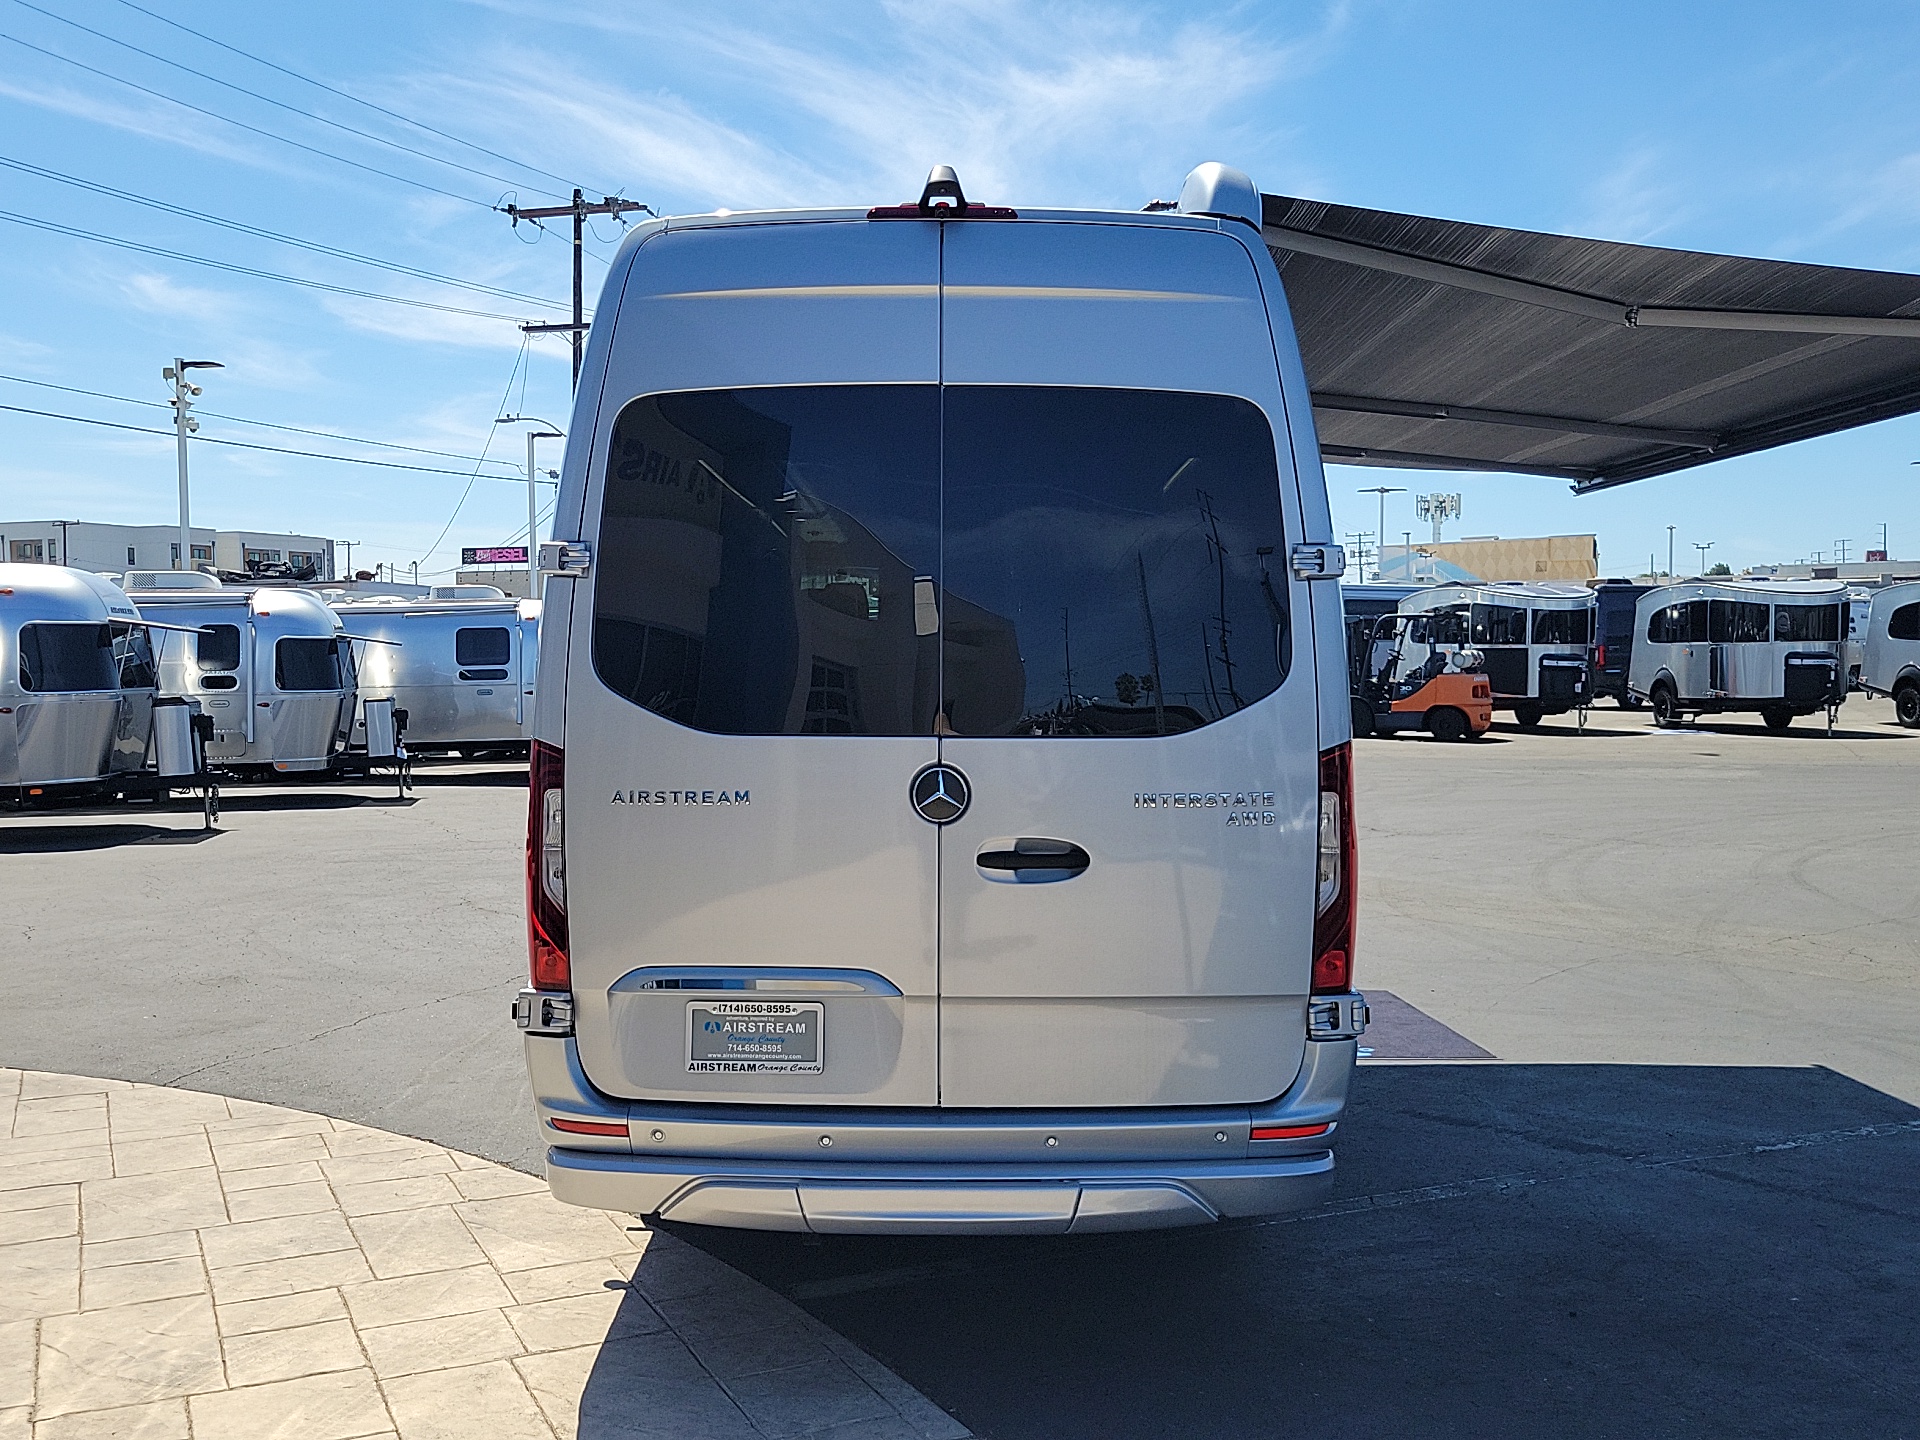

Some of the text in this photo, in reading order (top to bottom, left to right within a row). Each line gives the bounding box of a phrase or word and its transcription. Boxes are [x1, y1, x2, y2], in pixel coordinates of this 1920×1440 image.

[611, 790, 750, 806] AIRSTREAM
[1134, 792, 1275, 808] INTERSTATE
[1226, 811, 1276, 827] AWD
[723, 1022, 806, 1034] AIRSTREAM
[727, 1033, 785, 1044] Orange County
[727, 1044, 782, 1052] 714-650-8595
[688, 1062, 821, 1072] AIRSTREAM Orange County
